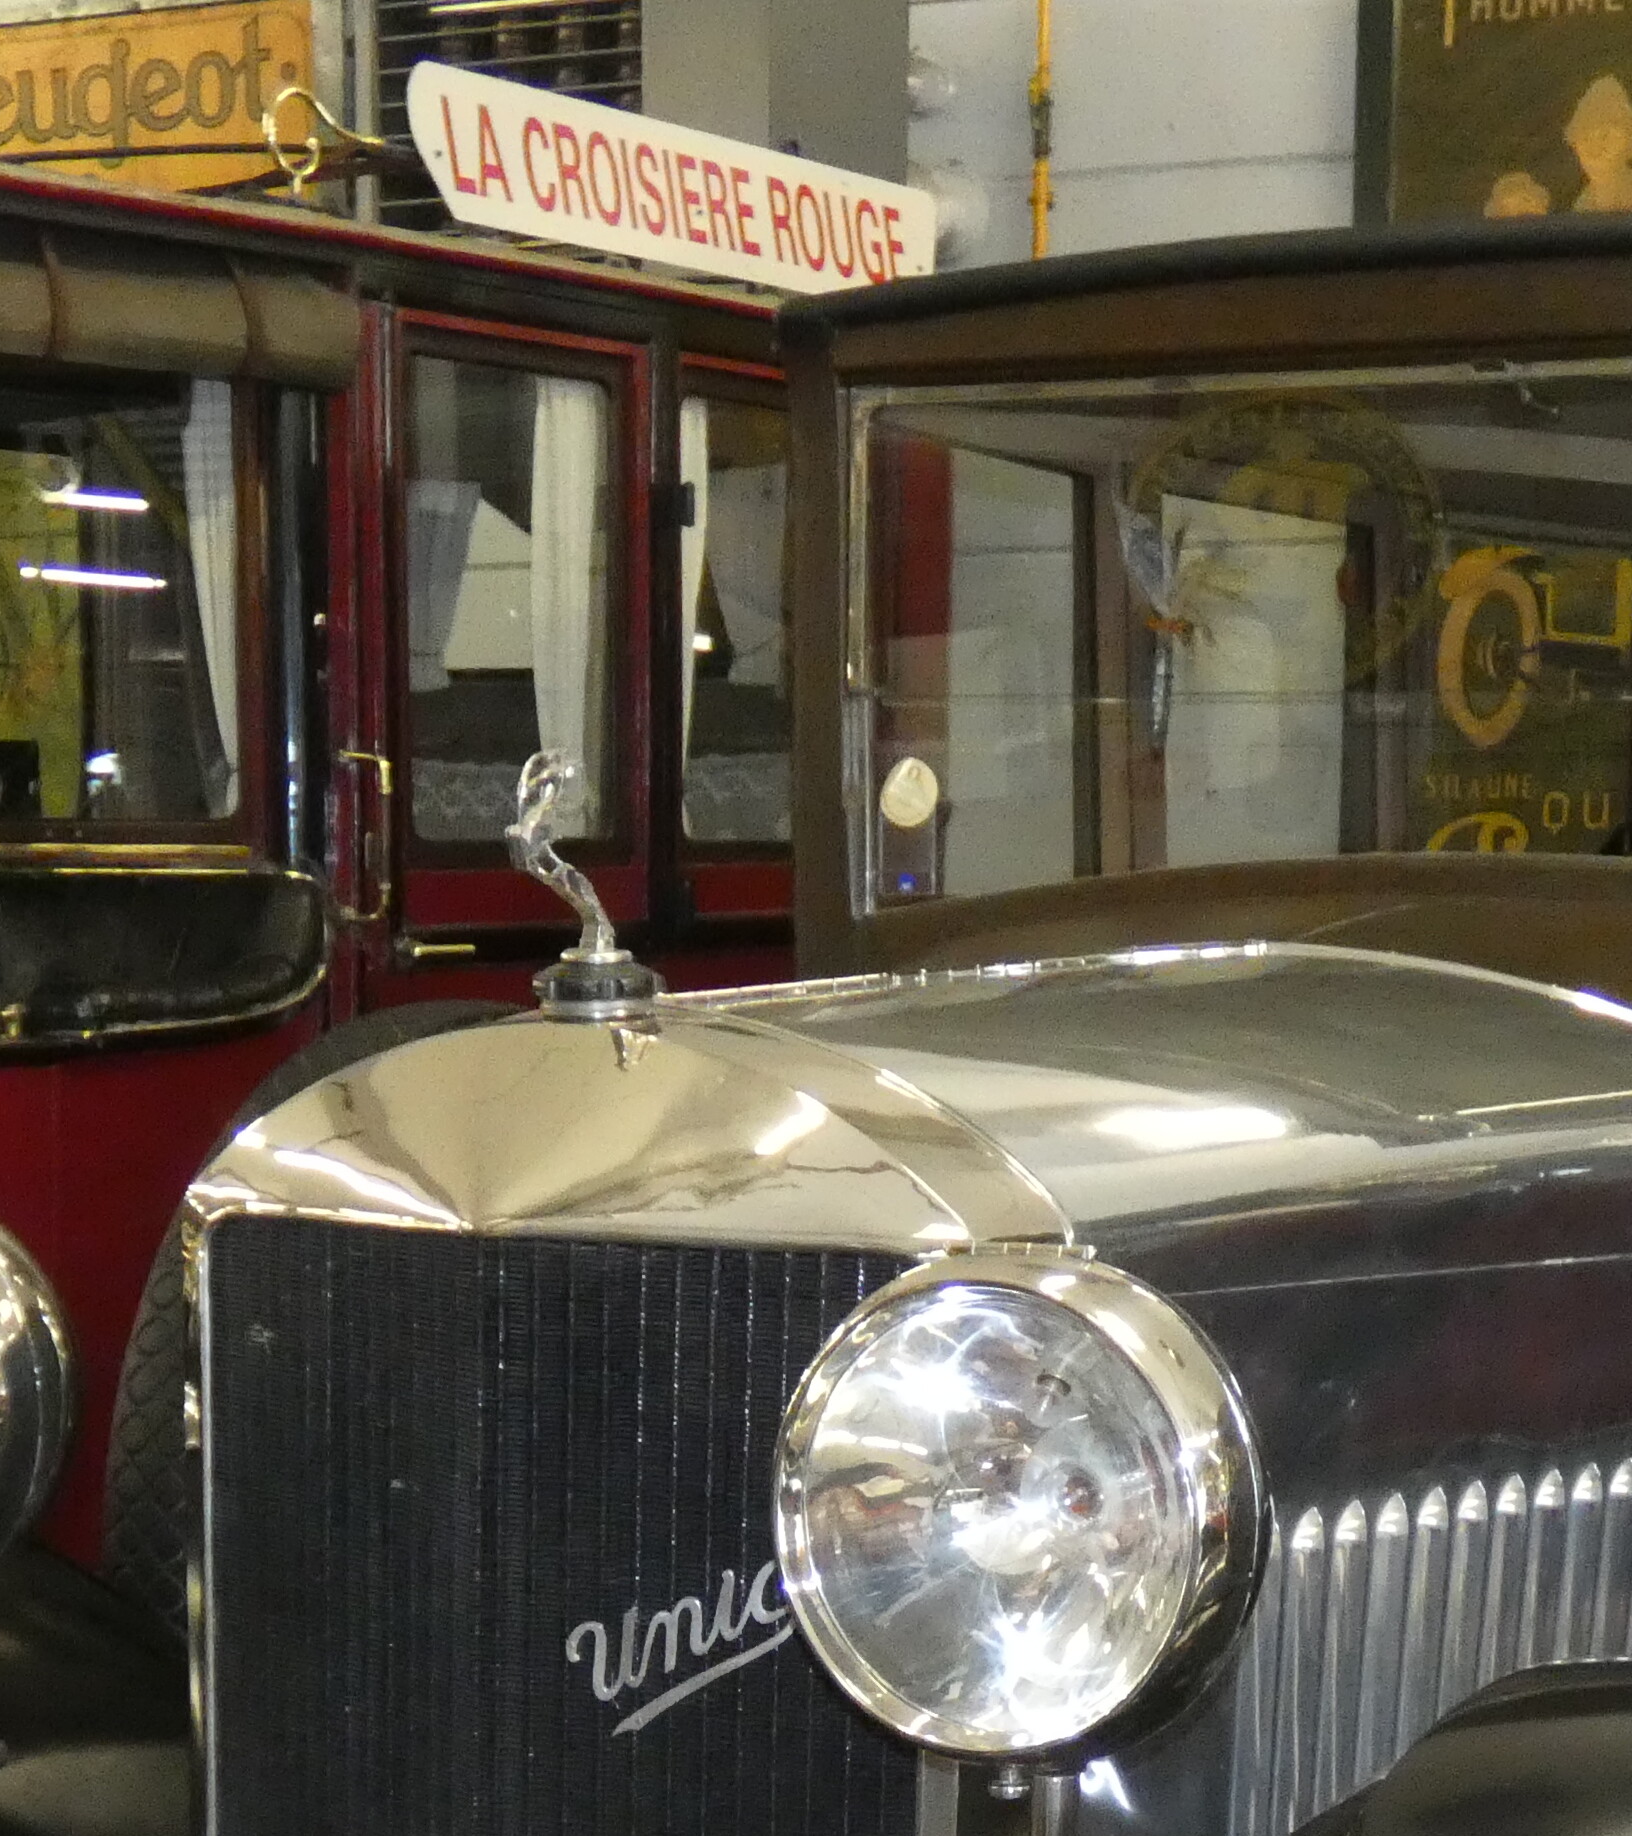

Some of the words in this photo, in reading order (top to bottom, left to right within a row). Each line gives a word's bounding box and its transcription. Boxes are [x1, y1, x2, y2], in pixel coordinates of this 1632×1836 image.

[439, 94, 514, 202] LA
[521, 115, 762, 257] CROISIERE
[767, 174, 905, 285] ROUGE
